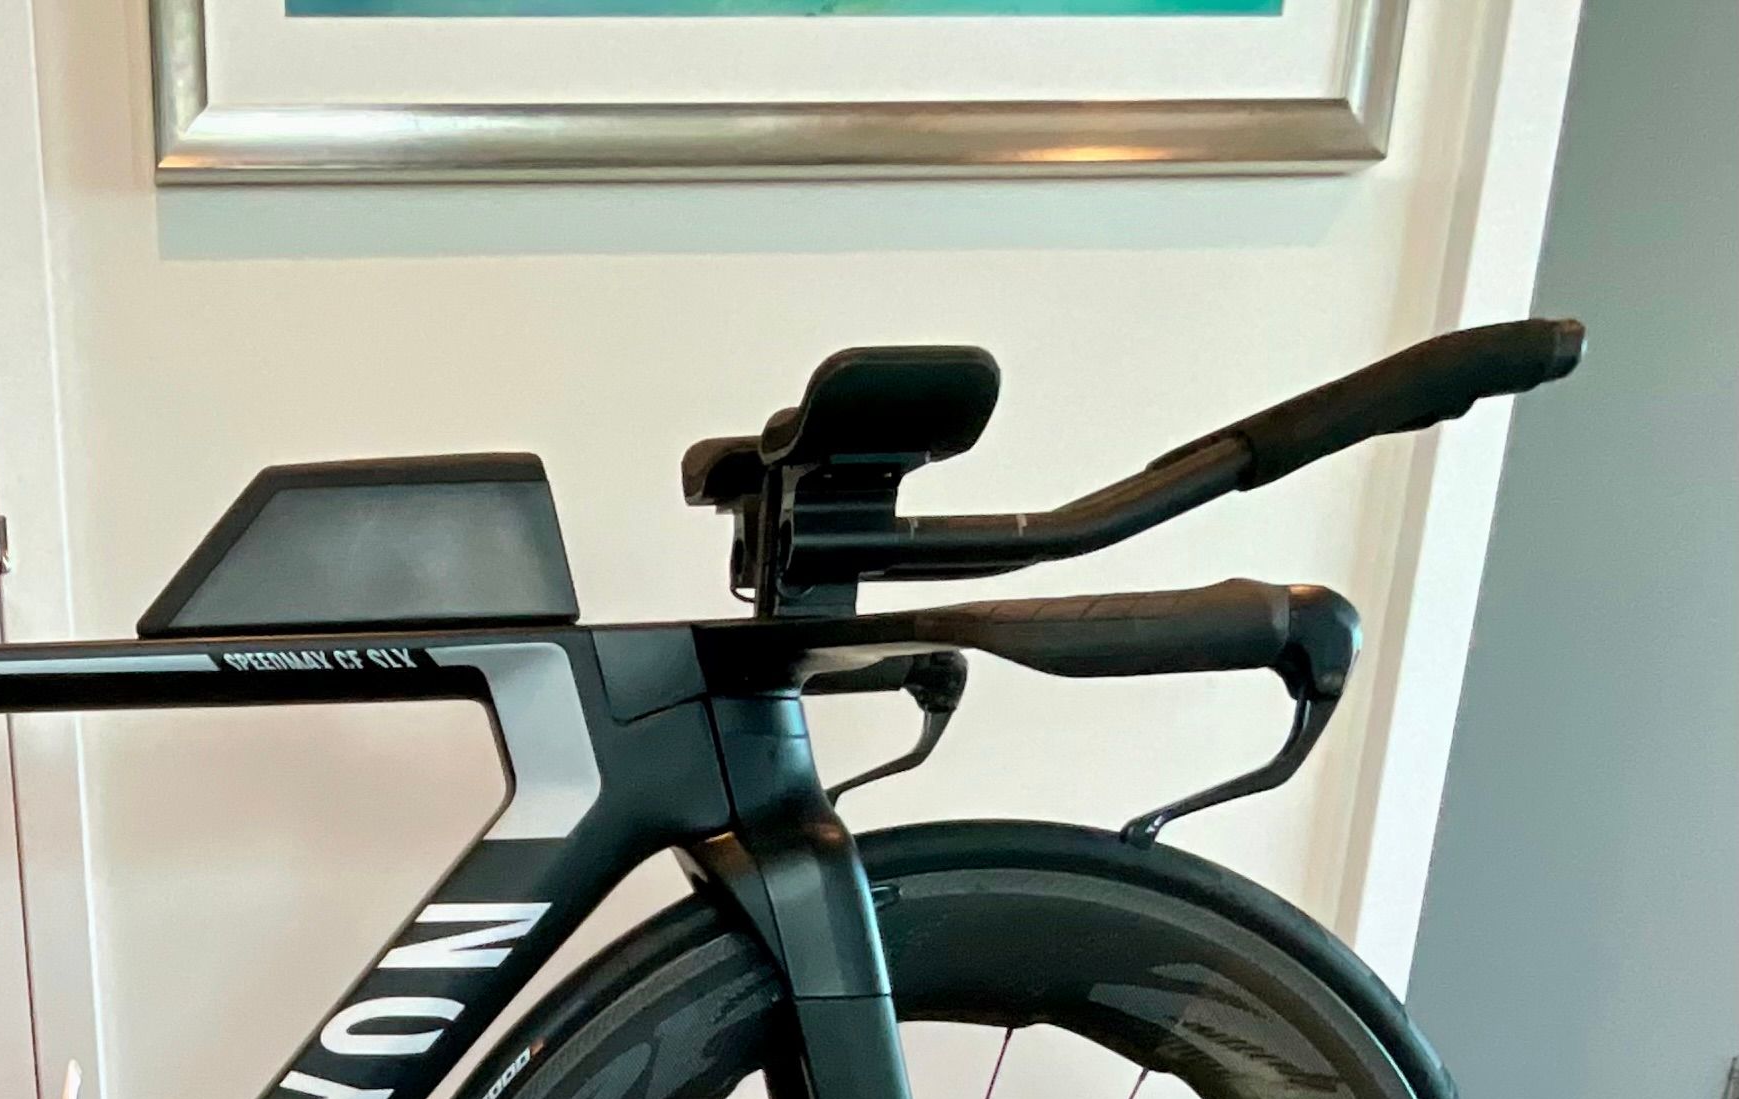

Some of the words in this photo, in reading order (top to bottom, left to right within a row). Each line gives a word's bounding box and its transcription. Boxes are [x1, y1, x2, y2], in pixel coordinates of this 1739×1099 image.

[223, 651, 334, 671] SPEEDMAX
[333, 649, 364, 670] CF
[366, 647, 417, 668] SLX
